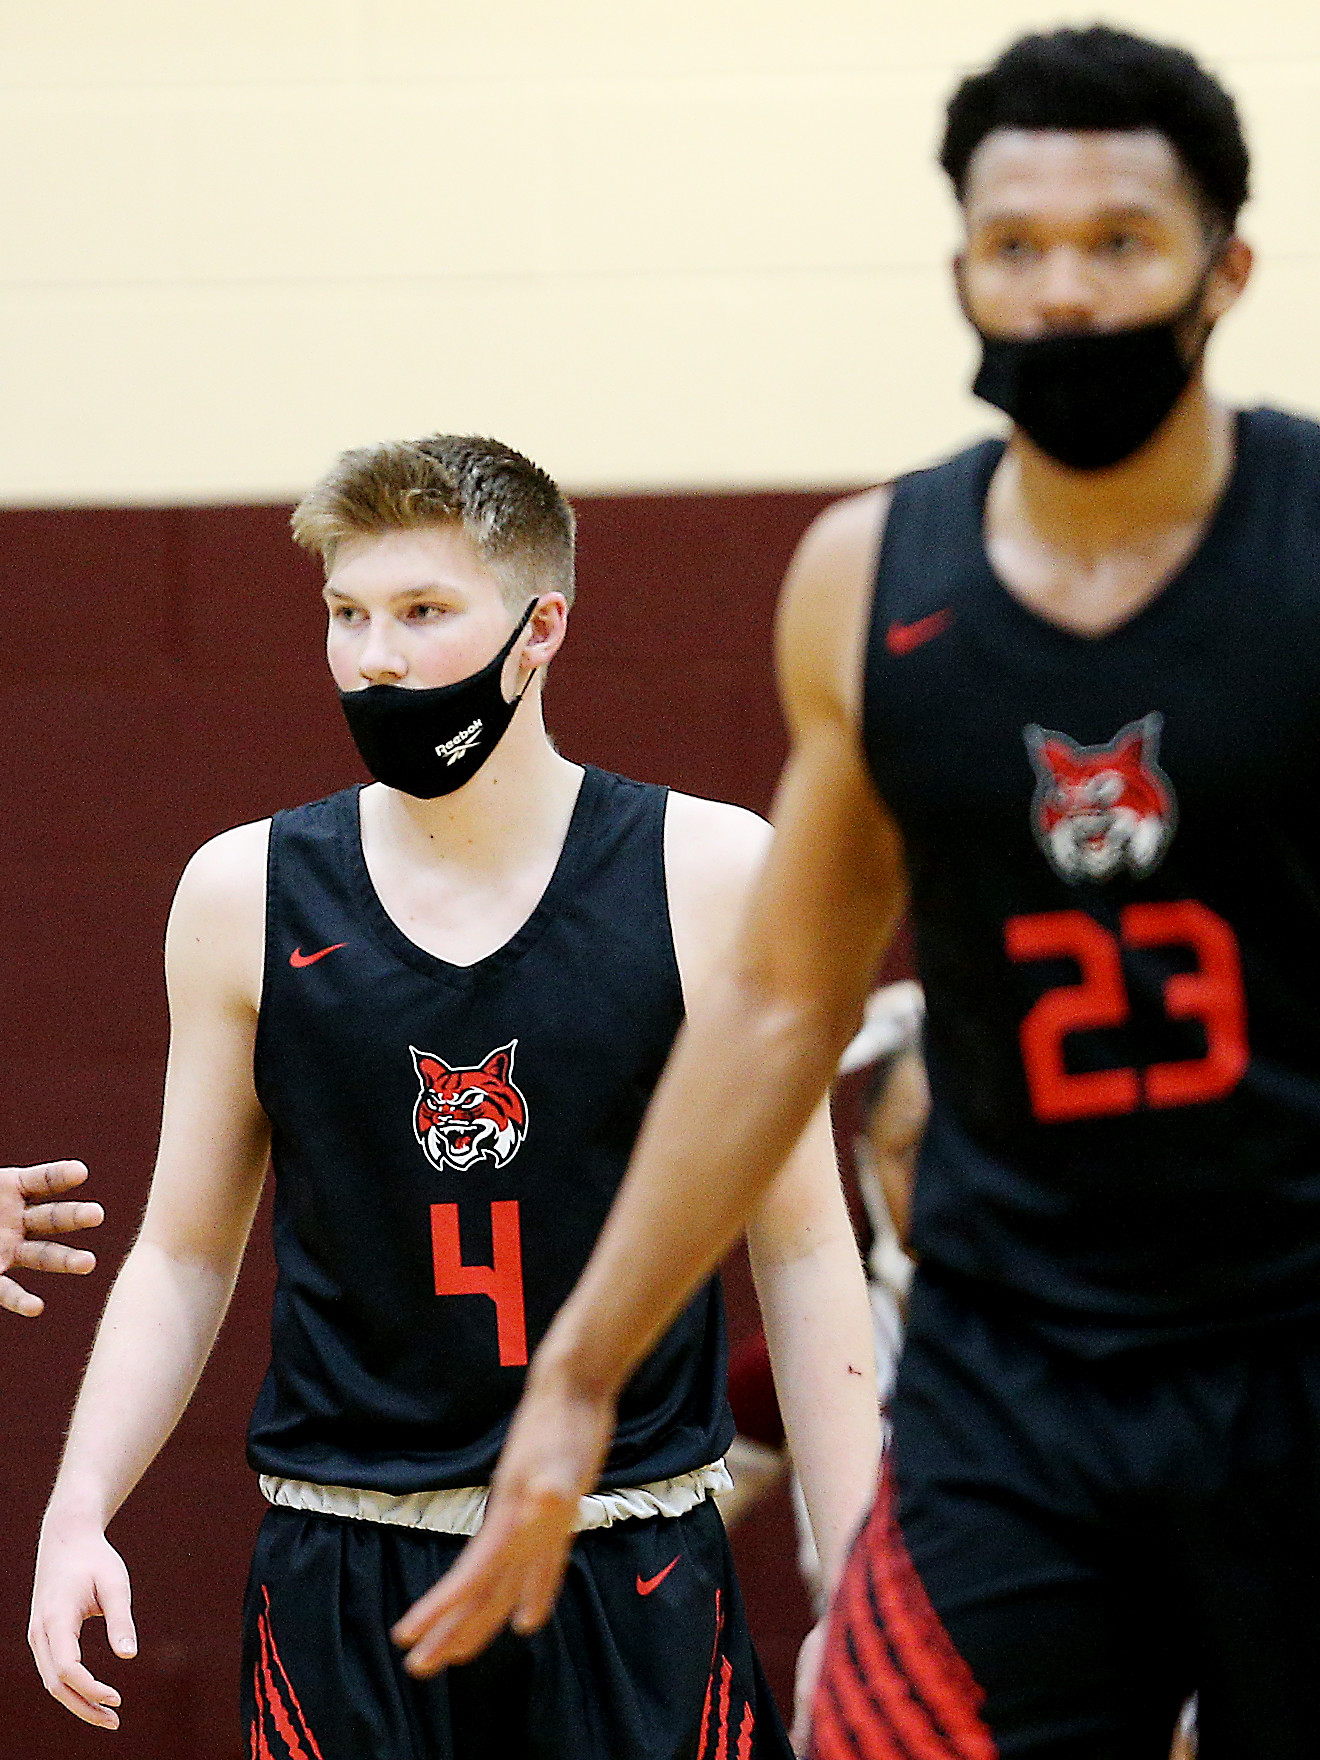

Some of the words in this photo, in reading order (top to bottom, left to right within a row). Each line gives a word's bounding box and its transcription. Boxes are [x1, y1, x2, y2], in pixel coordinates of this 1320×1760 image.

[434, 718, 484, 757] Reebok
[1004, 899, 1251, 1125] 23
[429, 1199, 529, 1367] 4
